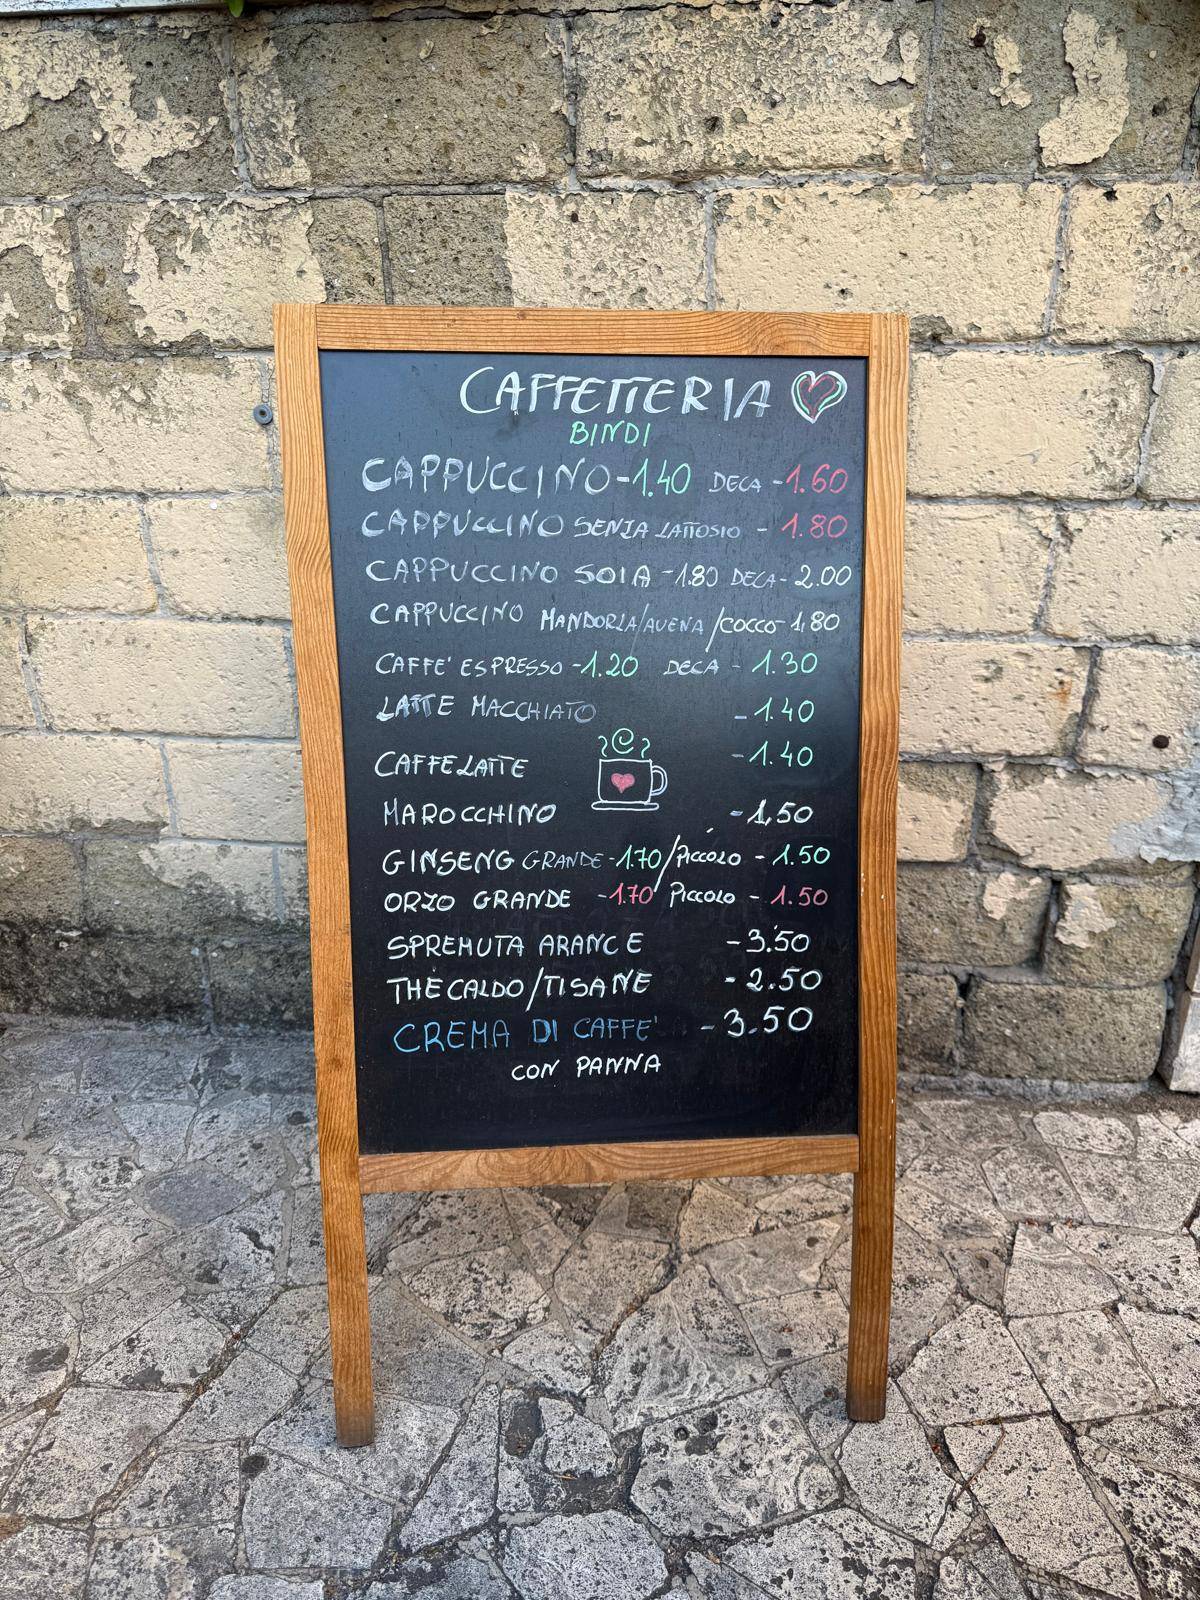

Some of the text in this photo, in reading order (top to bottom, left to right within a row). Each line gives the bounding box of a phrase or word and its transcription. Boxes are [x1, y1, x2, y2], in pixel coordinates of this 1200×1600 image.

[459, 366, 772, 422] CAFFETTERIA
[569, 419, 651, 448] BINDI
[361, 453, 611, 500] CAPPUCCINO
[708, 470, 763, 494] DECA
[361, 507, 565, 540] CAPPUCCINO
[654, 521, 741, 540] LATTOSIO
[365, 556, 559, 584] CAPPUCCINO
[573, 563, 651, 588] SOIA
[794, 564, 852, 590] 2.00
[369, 600, 524, 627] CAPPUCCINO
[460, 657, 563, 678] ESPRESSO
[662, 658, 720, 676] DECA
[751, 649, 818, 676] 1.30
[375, 692, 455, 722] LATTE
[470, 694, 597, 724] MACCHIATO
[383, 797, 557, 827] MAROCCHINO
[381, 847, 516, 877] GINSENG
[521, 849, 605, 871] GRANDE
[771, 843, 831, 867] 1.50
[383, 891, 456, 914] ORZO
[472, 889, 572, 911] GRANDE
[770, 884, 829, 907] 1.50
[386, 933, 526, 960] SPREMUTA
[538, 931, 645, 958] ARANCE
[745, 965, 824, 993] 2.50
[392, 1019, 511, 1054] CREMA
[531, 1018, 558, 1044] DI
[723, 1004, 814, 1039] 3.50
[510, 1052, 662, 1082] CON PANNA
